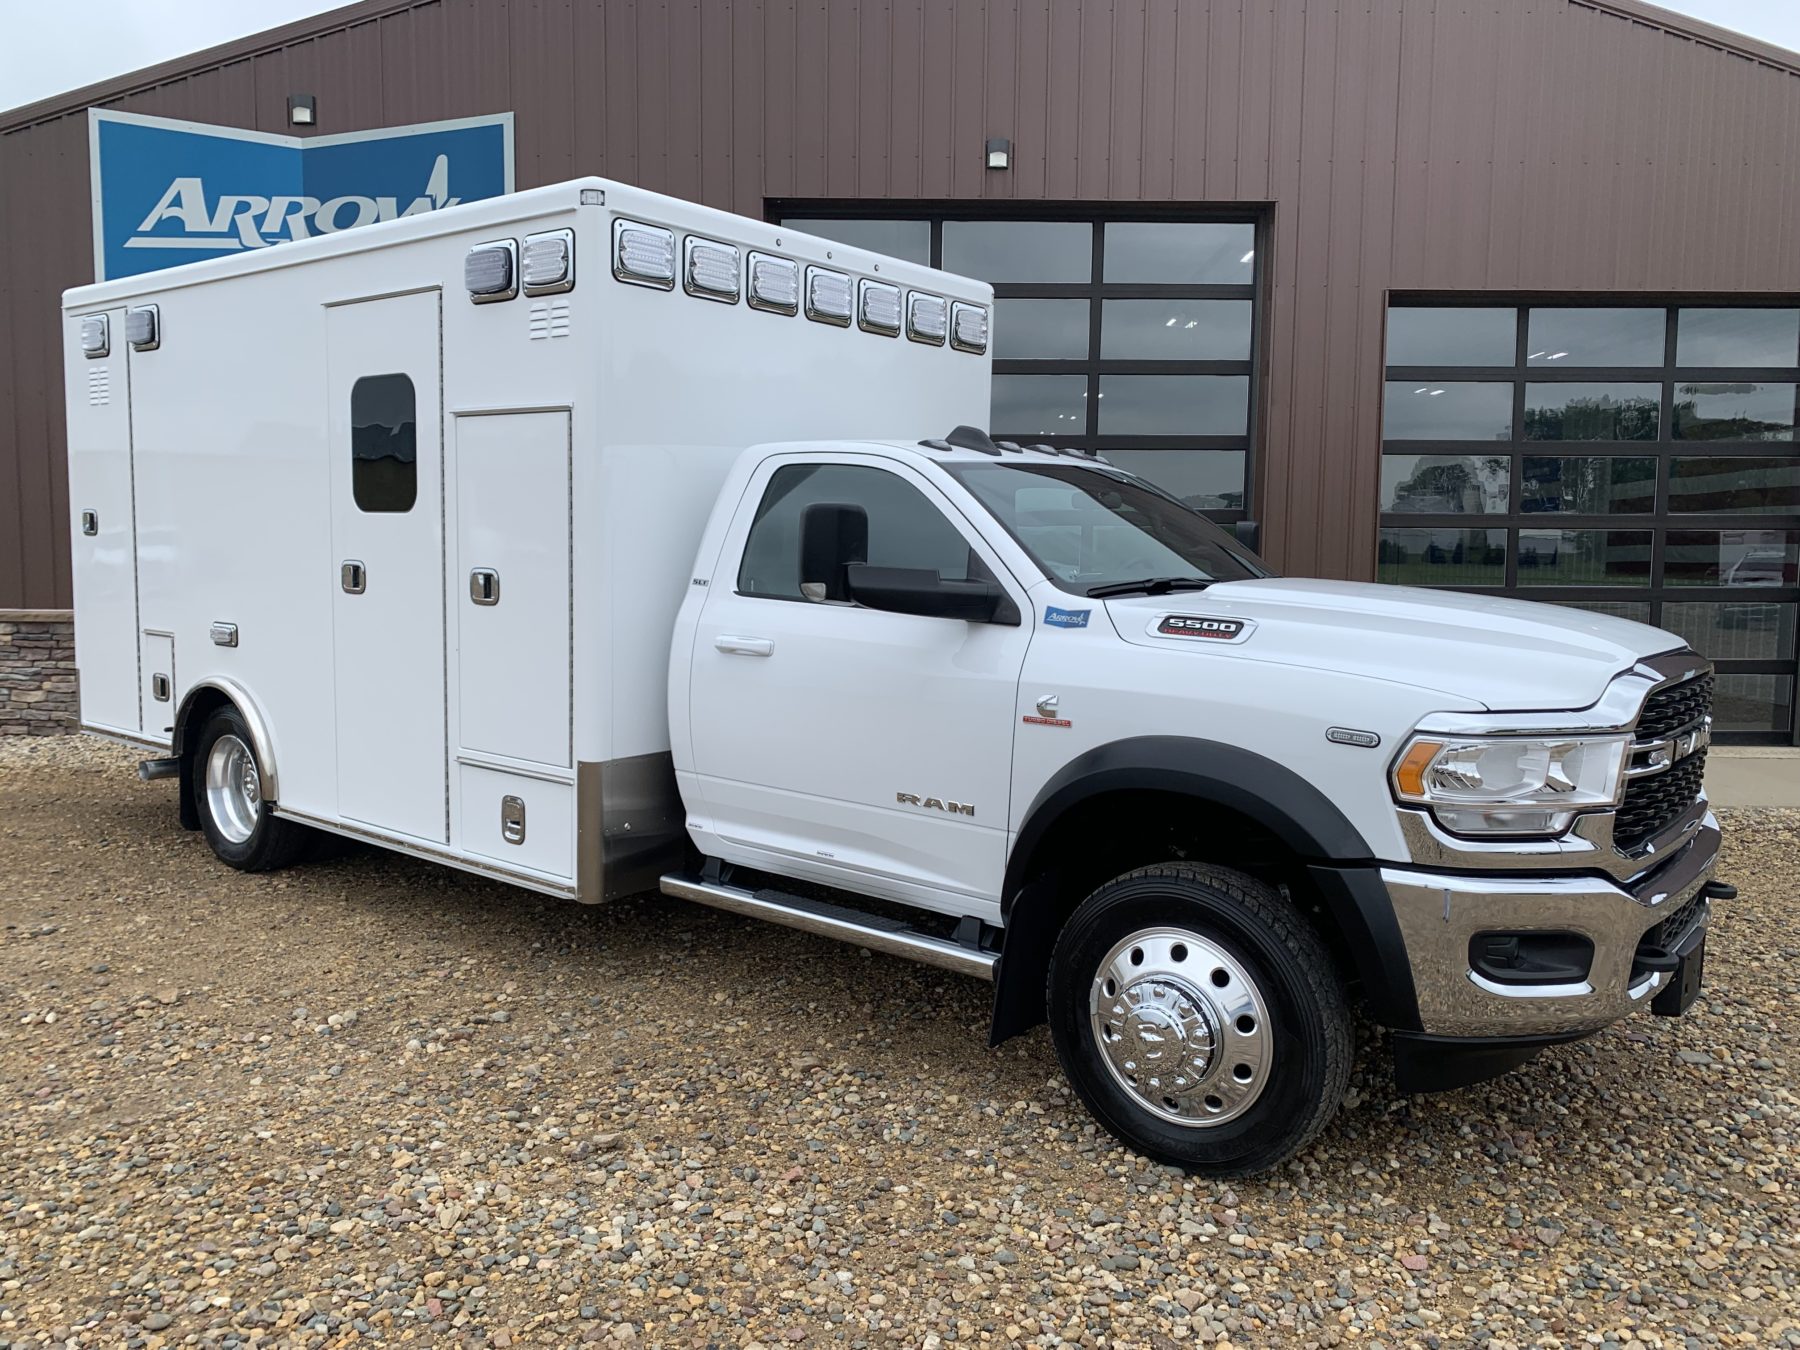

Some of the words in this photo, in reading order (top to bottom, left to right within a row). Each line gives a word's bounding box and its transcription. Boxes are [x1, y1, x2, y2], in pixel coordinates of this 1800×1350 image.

[128, 176, 461, 248] ARROW
[1163, 627, 1199, 636] HEAVY
[1201, 631, 1233, 640] DUTY
[1169, 618, 1237, 632] 5500
[896, 791, 975, 816] RAM
